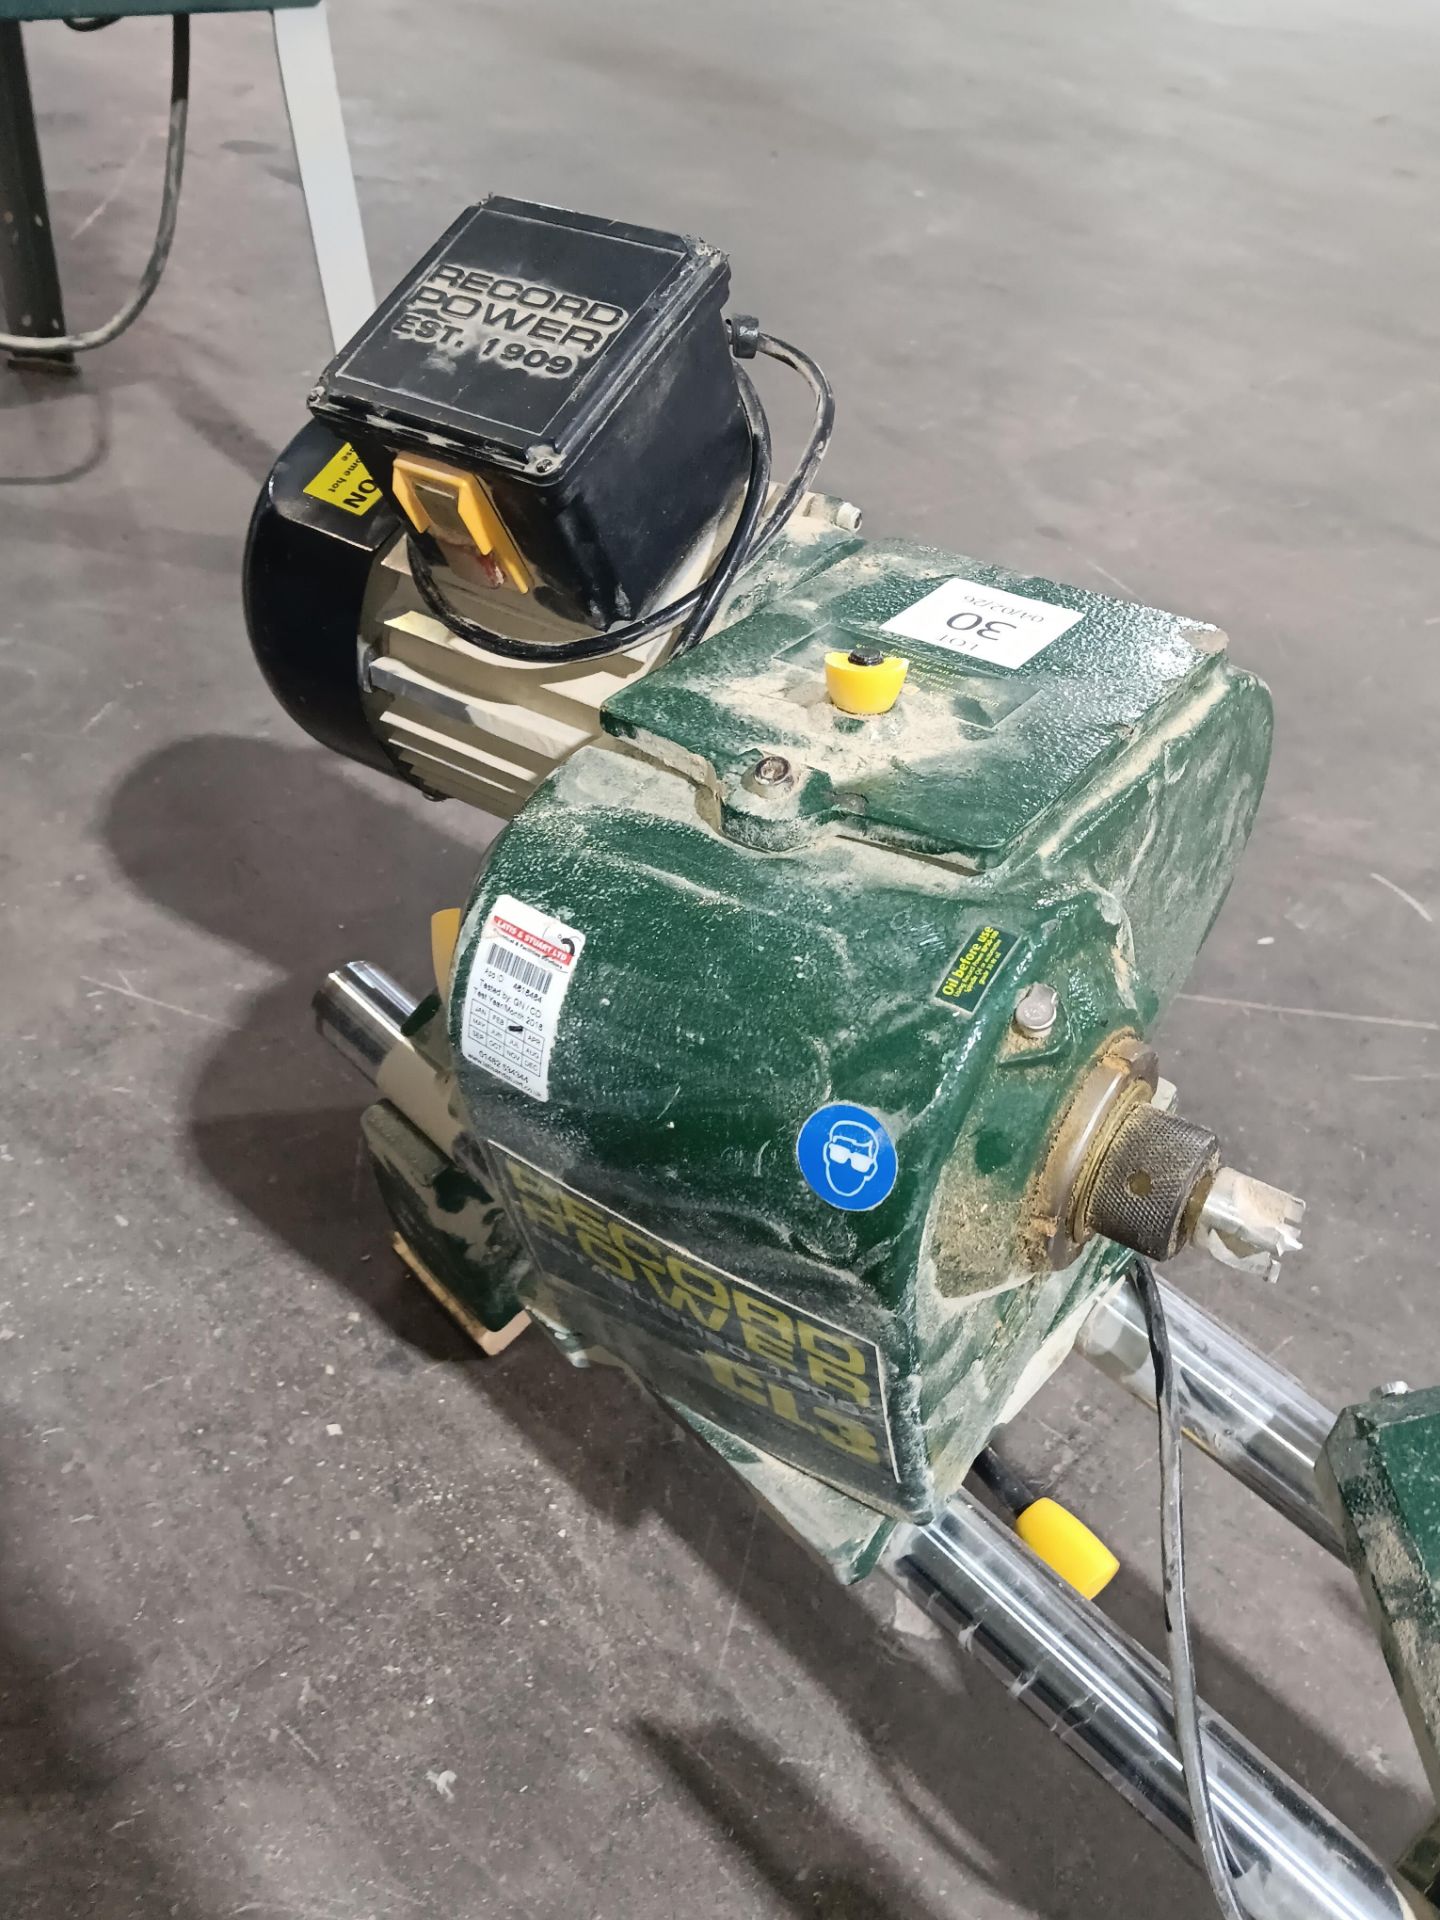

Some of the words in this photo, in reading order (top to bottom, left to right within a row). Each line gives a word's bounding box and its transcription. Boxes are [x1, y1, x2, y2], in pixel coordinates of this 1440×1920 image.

[406, 286, 603, 353] POWER
[428, 264, 624, 326] RECORD
[394, 313, 464, 348] EST.
[481, 337, 573, 374] 1909
[328, 478, 347, 493] hot
[343, 479, 377, 509] ON
[946, 613, 1017, 641] 30
[518, 930, 523, 939] &
[524, 933, 552, 953] STUART
[552, 947, 566, 961] LTD
[942, 978, 959, 996] Oil
[951, 943, 982, 979] before
[978, 926, 994, 943] use
[474, 987, 488, 1002] Test
[492, 1013, 505, 1025] FEB
[507, 1160, 866, 1378] RECORD
[521, 1192, 871, 1408] POWER
[704, 1350, 880, 1465] CL3
